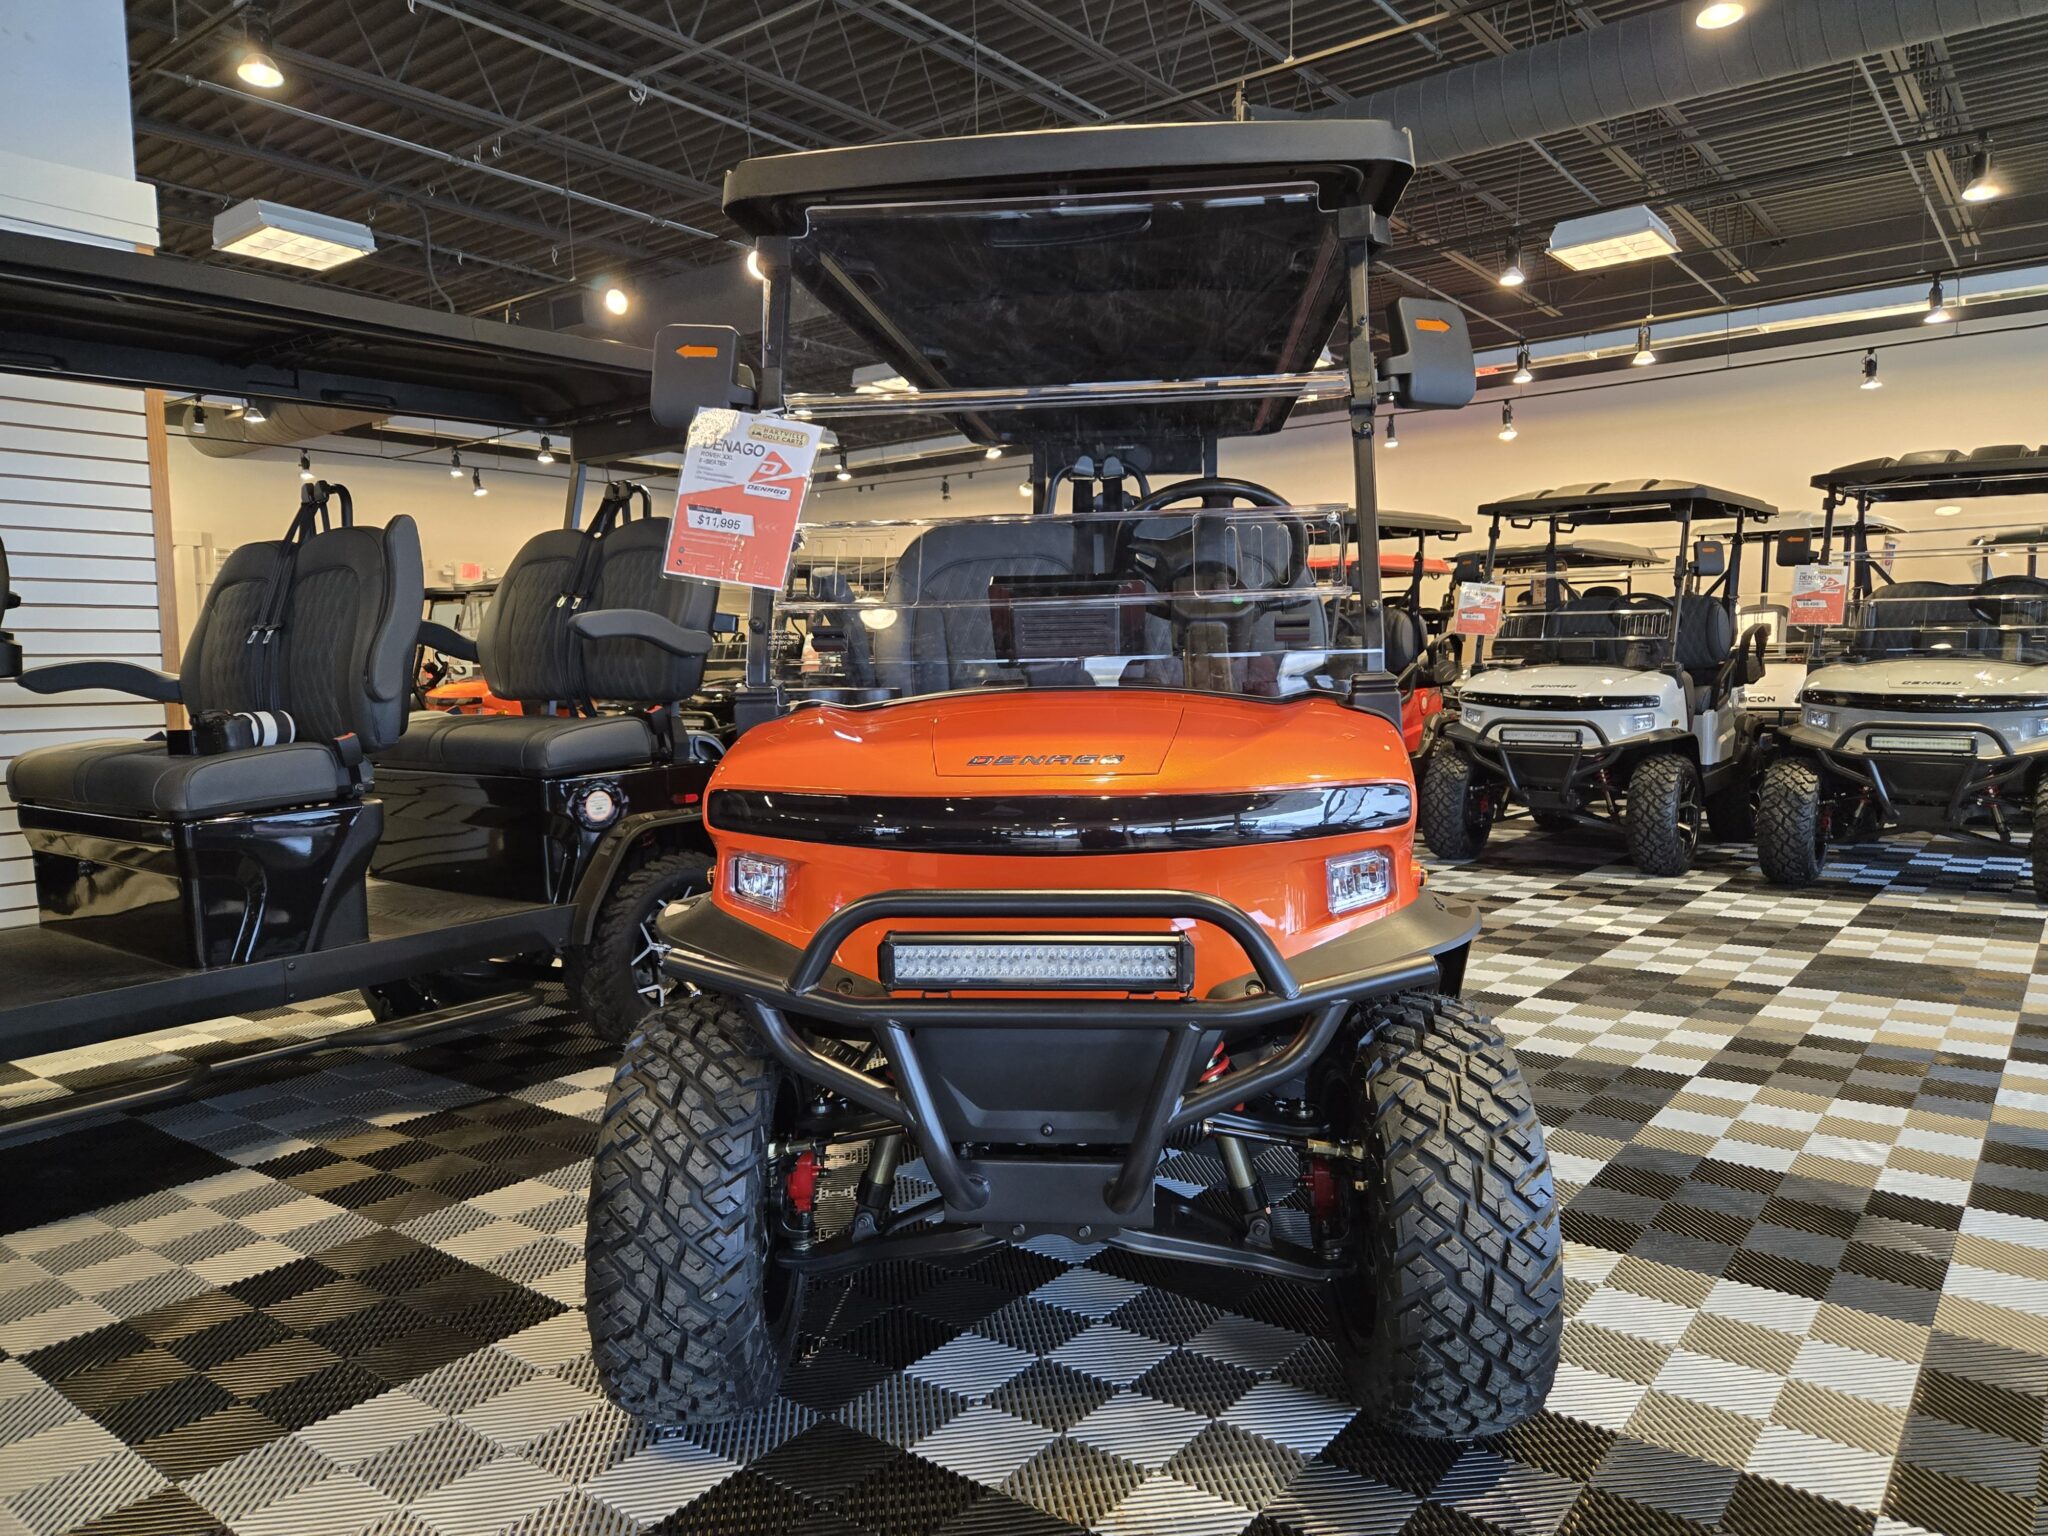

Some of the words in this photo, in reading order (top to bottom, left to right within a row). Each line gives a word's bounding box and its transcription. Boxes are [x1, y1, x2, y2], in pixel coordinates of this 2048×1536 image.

[762, 433, 780, 442] GOLF
[781, 436, 804, 446] CARTS
[763, 426, 805, 440] HARTVILLE
[702, 436, 766, 457] DENAGO
[747, 484, 787, 495] DENAGO
[697, 514, 741, 529] $11,995
[967, 755, 1125, 766] DENAGO
